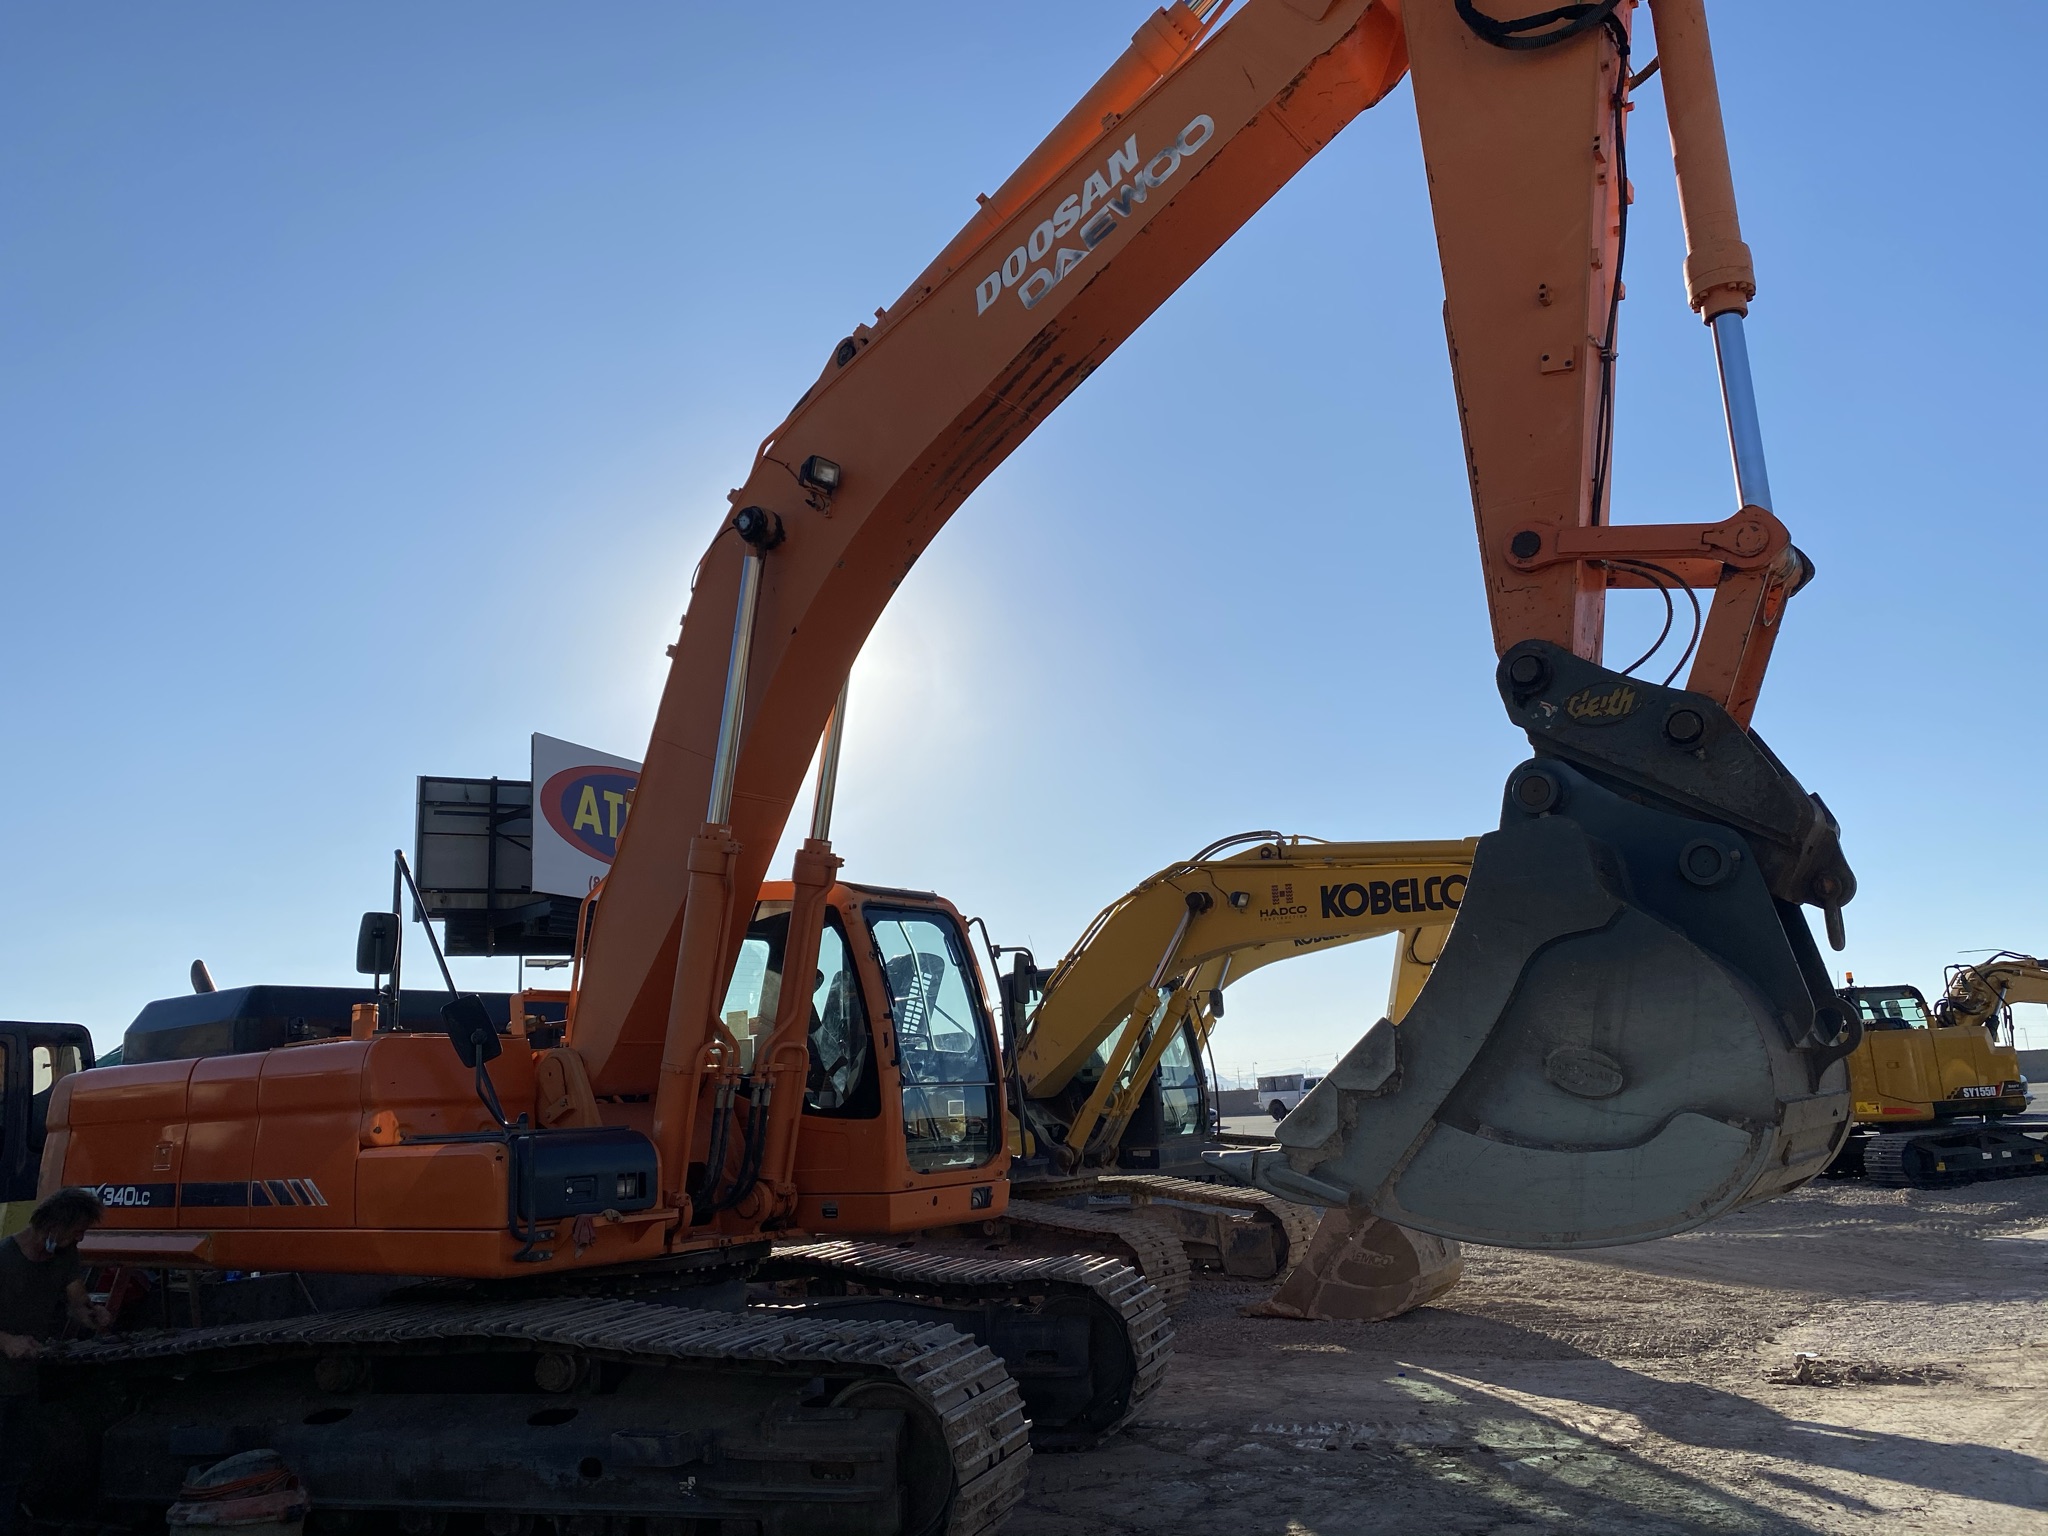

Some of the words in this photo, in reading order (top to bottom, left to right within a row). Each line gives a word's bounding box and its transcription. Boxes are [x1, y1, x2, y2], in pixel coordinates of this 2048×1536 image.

[976, 133, 1139, 317] DOOSAN
[1017, 114, 1215, 310] DAEWOO
[573, 785, 632, 838] AT
[1260, 905, 1308, 917] HADCO
[1320, 874, 1469, 918] KOBELCO
[78, 1182, 150, 1206] X340LC
